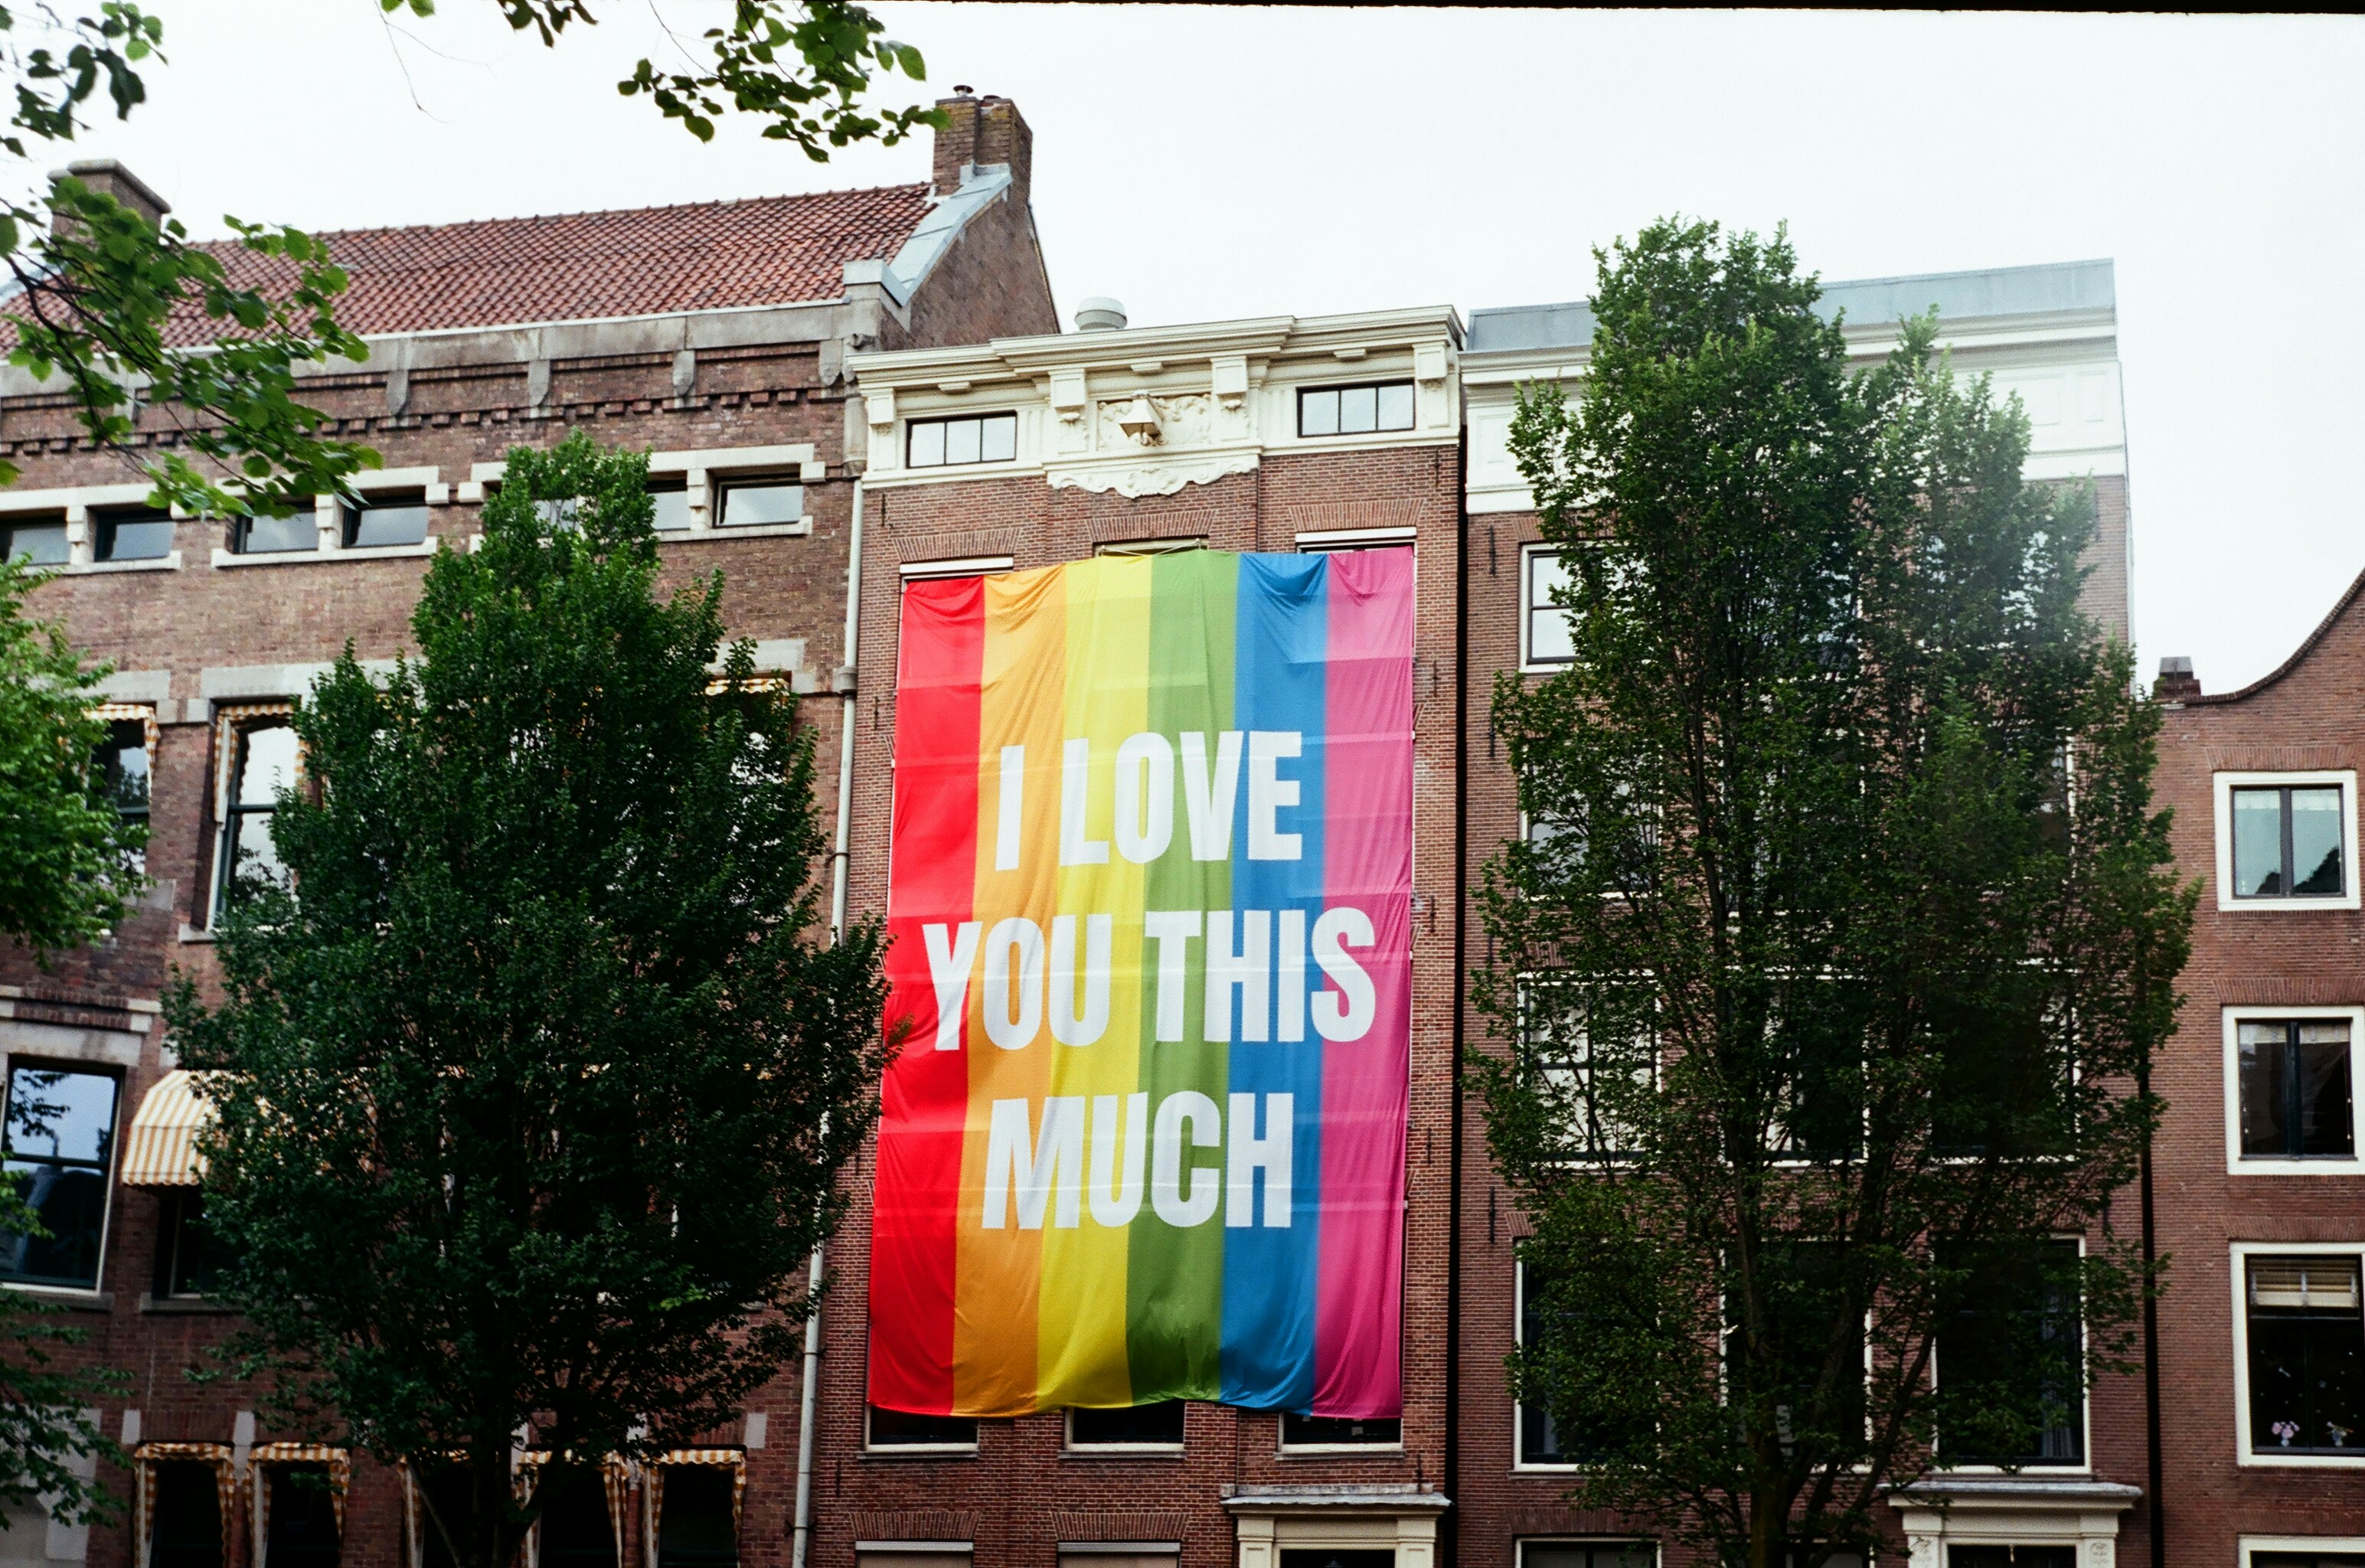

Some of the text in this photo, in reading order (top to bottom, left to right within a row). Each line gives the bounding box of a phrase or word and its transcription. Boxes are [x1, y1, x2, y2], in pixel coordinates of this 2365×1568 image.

[995, 730, 1302, 871] I LOVE
[923, 906, 1376, 1051] YOU THIS
[982, 1091, 1294, 1230] MUCH
